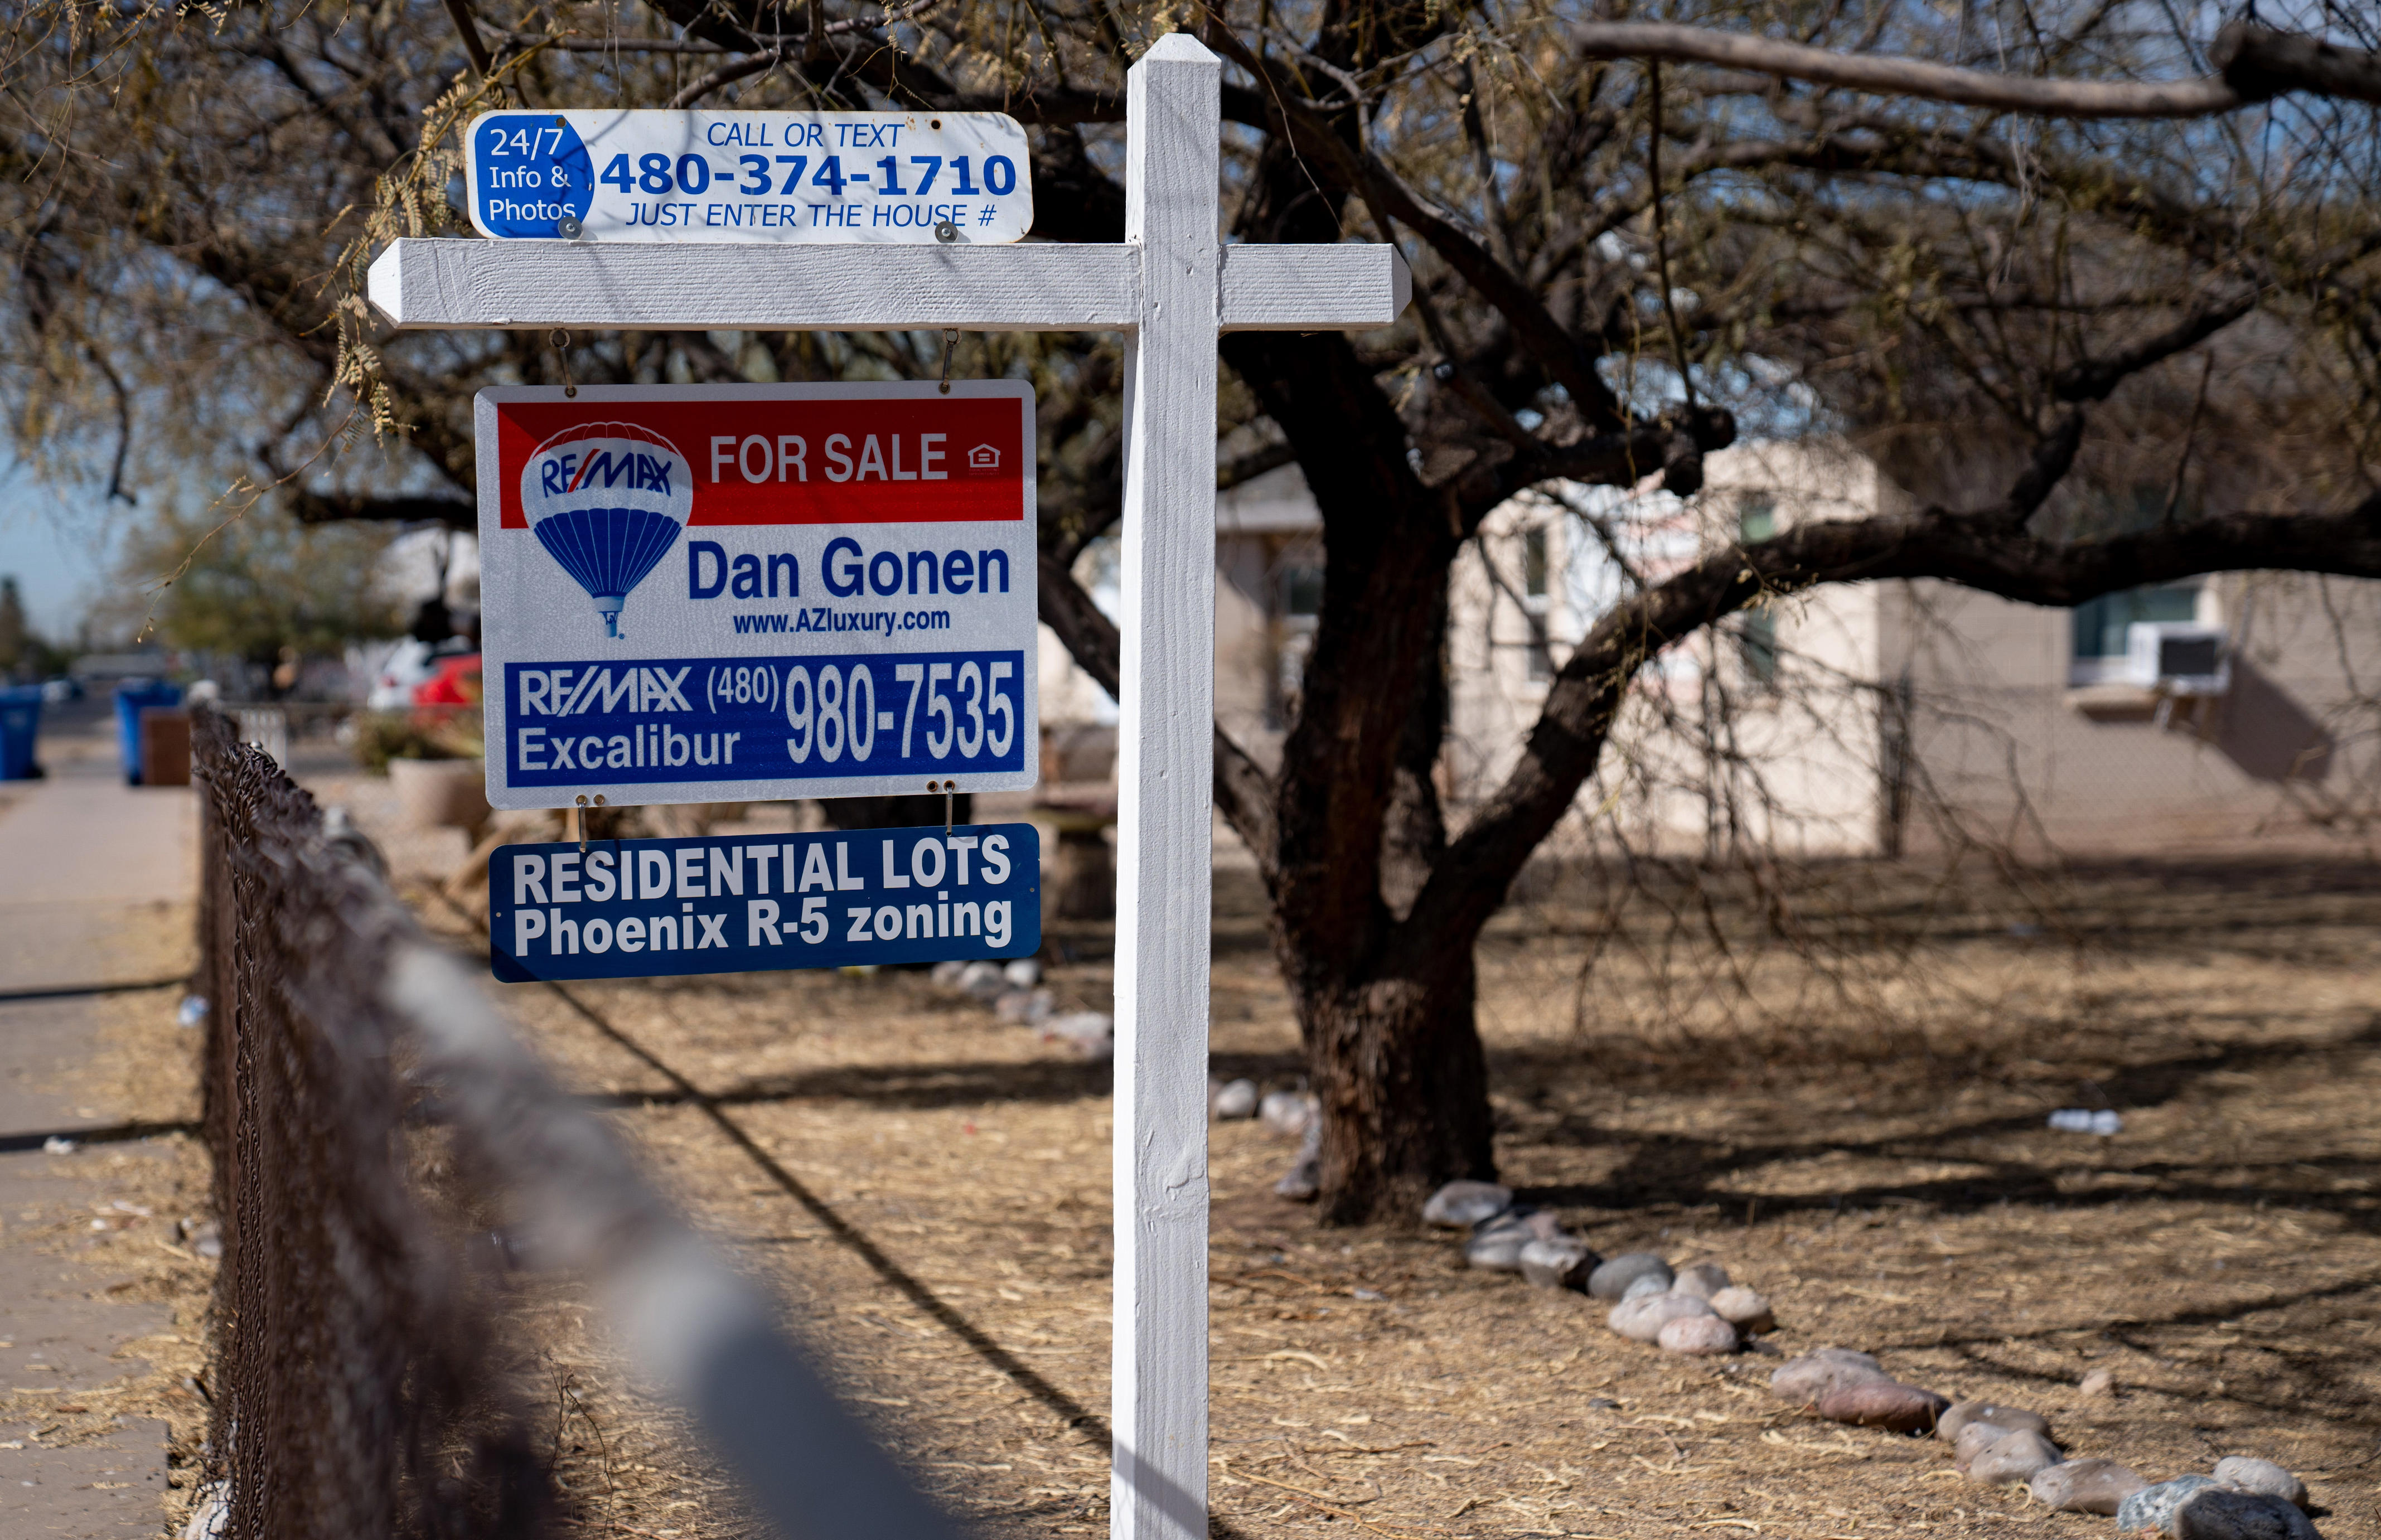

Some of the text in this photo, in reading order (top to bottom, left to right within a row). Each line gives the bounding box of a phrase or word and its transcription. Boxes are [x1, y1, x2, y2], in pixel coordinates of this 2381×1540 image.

[490, 128, 563, 161] 24/7
[708, 122, 904, 147] CALL OR TEXT
[489, 166, 572, 188] Info &
[600, 153, 1016, 195] 480-374-1710
[489, 198, 576, 221] Photos
[626, 203, 997, 227] JUST ENTER THE HOUSE #
[541, 448, 672, 498] RE/MAX
[710, 433, 948, 484] FOR SALE
[688, 536, 1009, 599] Dan Gonen
[733, 607, 950, 637] www.AZluxury.com
[519, 666, 693, 717] RE/MAX
[707, 661, 1014, 763] (480) 980-7535
[518, 724, 741, 771] Excalibur
[514, 835, 1011, 904] RESIDENTIAL LOTS
[515, 891, 1012, 956] Phoenix R-5 zoning
